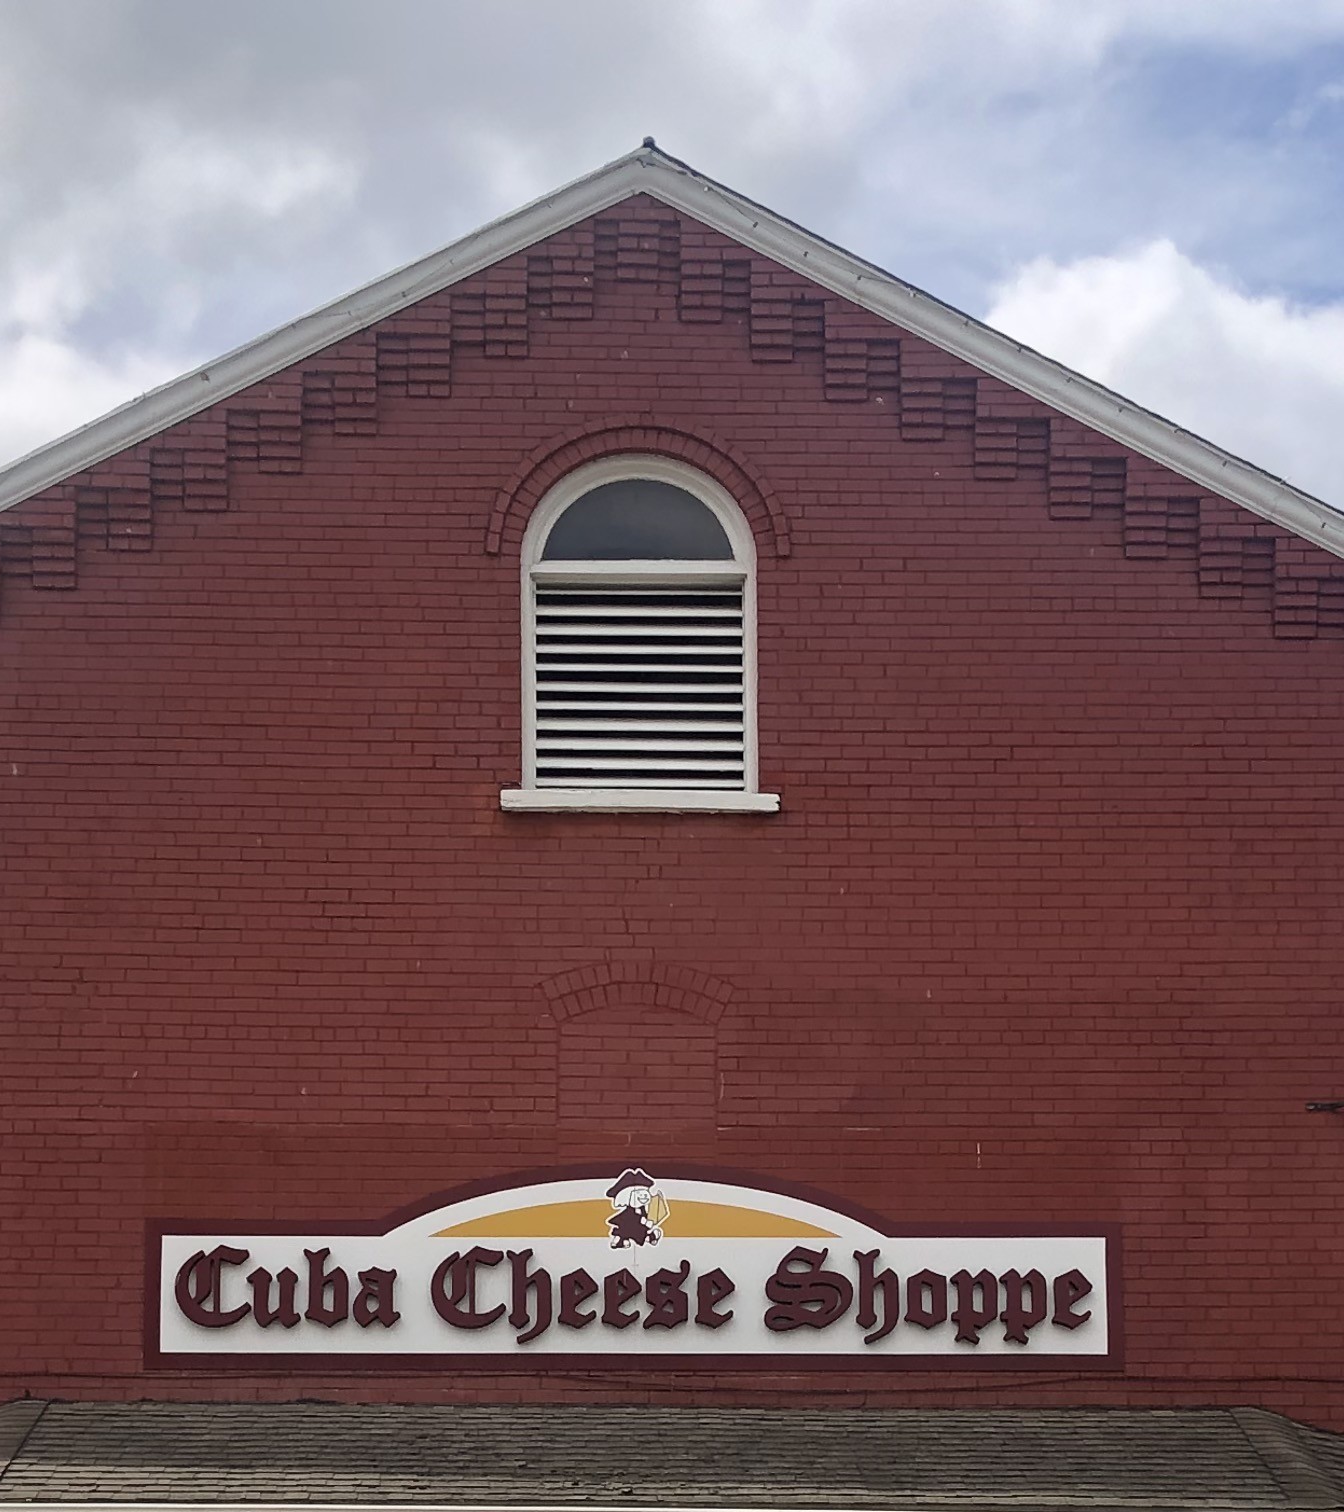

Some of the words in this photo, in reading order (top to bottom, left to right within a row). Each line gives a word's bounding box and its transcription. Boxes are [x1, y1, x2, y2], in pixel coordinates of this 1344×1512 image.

[174, 1244, 402, 1329] Cuba
[431, 1245, 736, 1345] Cheese
[764, 1245, 1093, 1345] Shoppe
